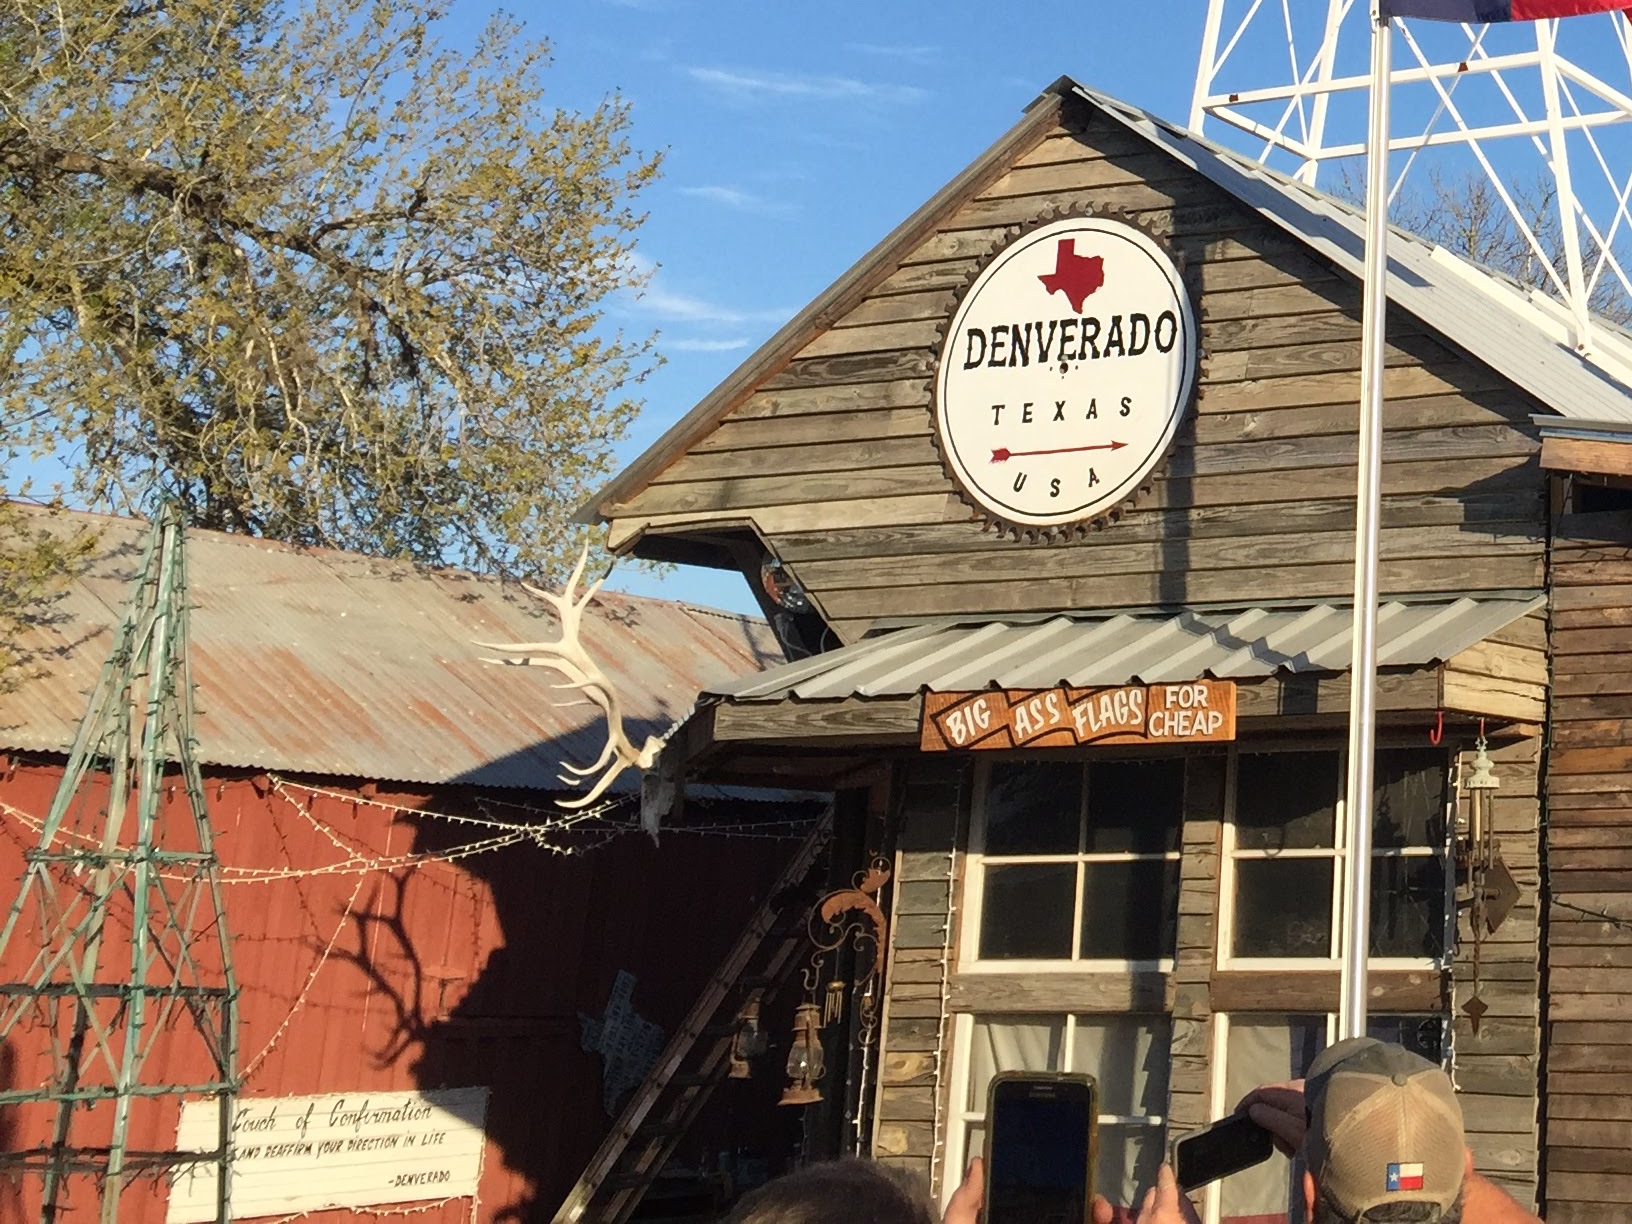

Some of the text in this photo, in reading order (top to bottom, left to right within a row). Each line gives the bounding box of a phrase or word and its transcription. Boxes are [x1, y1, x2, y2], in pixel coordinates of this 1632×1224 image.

[963, 310, 1178, 371] DENVERADO
[991, 396, 1132, 426] TEXAS
[1013, 468, 1100, 498] USA
[1165, 685, 1209, 709] FOR
[945, 688, 1142, 744] BIG ASS FLAGS
[1149, 710, 1223, 737] CHEAP
[232, 1098, 432, 1139] Couch of Confirmation
[237, 1147, 261, 1161] AND
[263, 1143, 313, 1158] REAFFIRM
[316, 1139, 344, 1159] YOUR
[347, 1135, 399, 1151] DIRECTION
[402, 1130, 416, 1148] IN
[421, 1129, 446, 1146] LIFE
